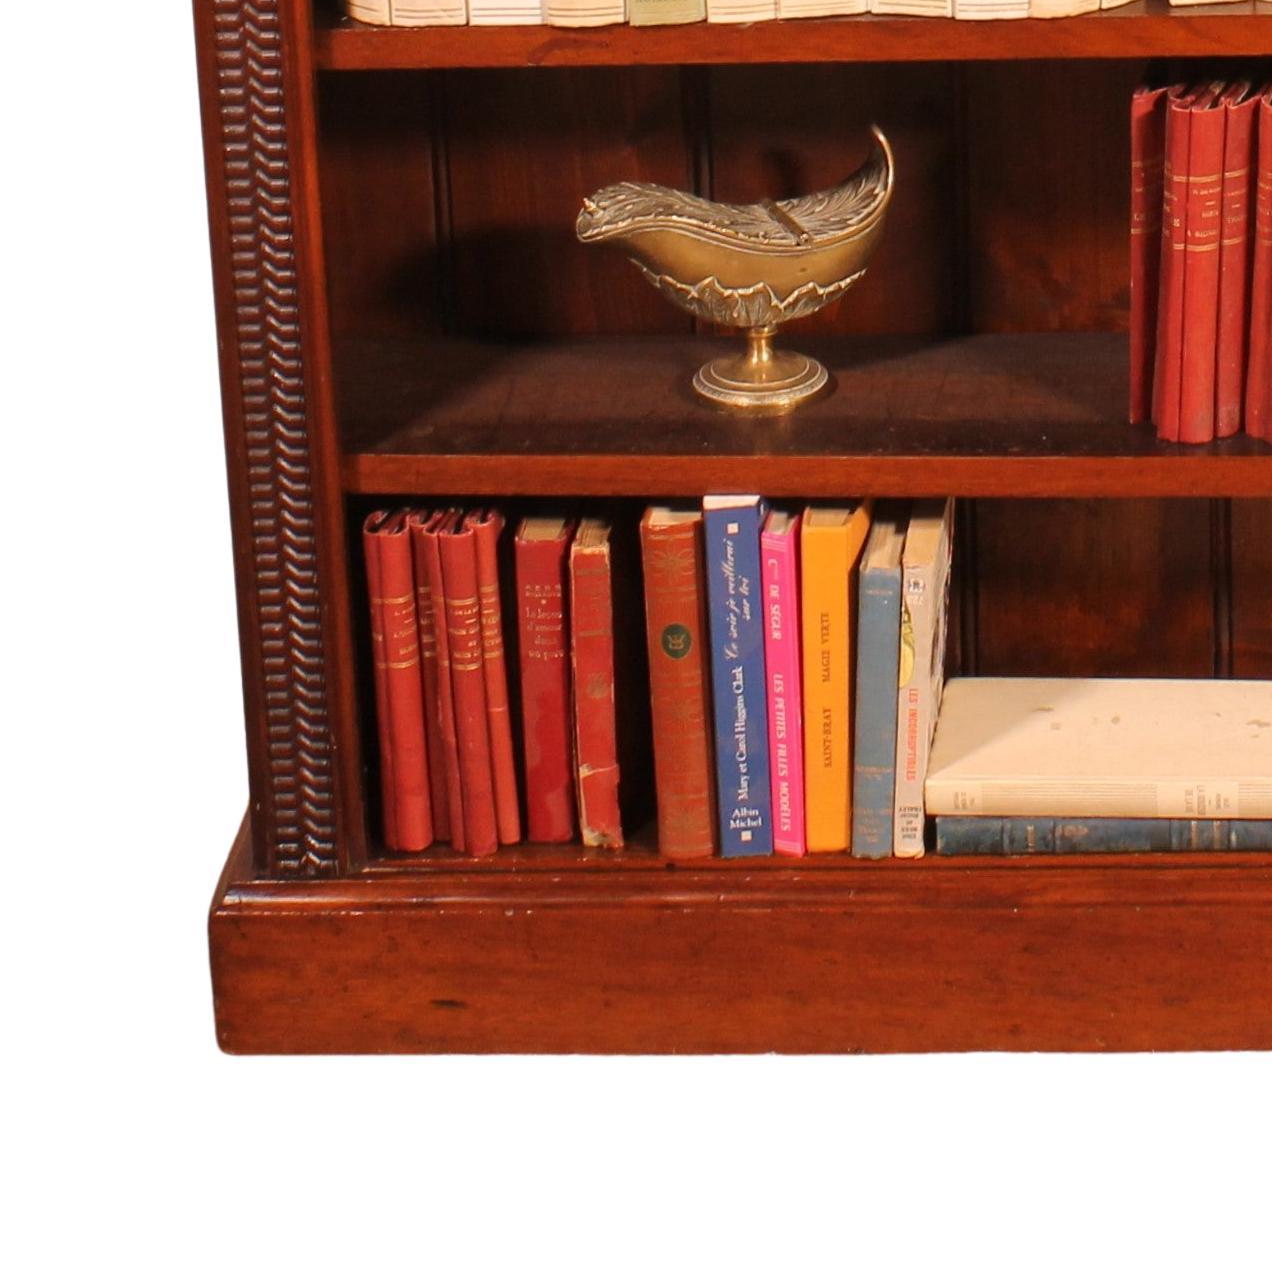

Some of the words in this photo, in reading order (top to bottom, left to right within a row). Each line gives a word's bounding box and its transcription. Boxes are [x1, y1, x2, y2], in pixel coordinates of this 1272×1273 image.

[820, 612, 830, 645] VERTE
[731, 665, 744, 695] Clark
[821, 649, 831, 684] MAGIE
[774, 673, 784, 693] LES
[907, 688, 919, 704] LES
[733, 695, 748, 732] Higgins
[775, 696, 787, 740] PETITES
[735, 732, 748, 762] Carol
[822, 707, 832, 769] SAINT-BRAY
[739, 762, 748, 773] et
[777, 743, 788, 777] FILLES
[737, 773, 750, 801] Mary
[729, 817, 762, 830] Michel
[732, 807, 759, 818] Albin
